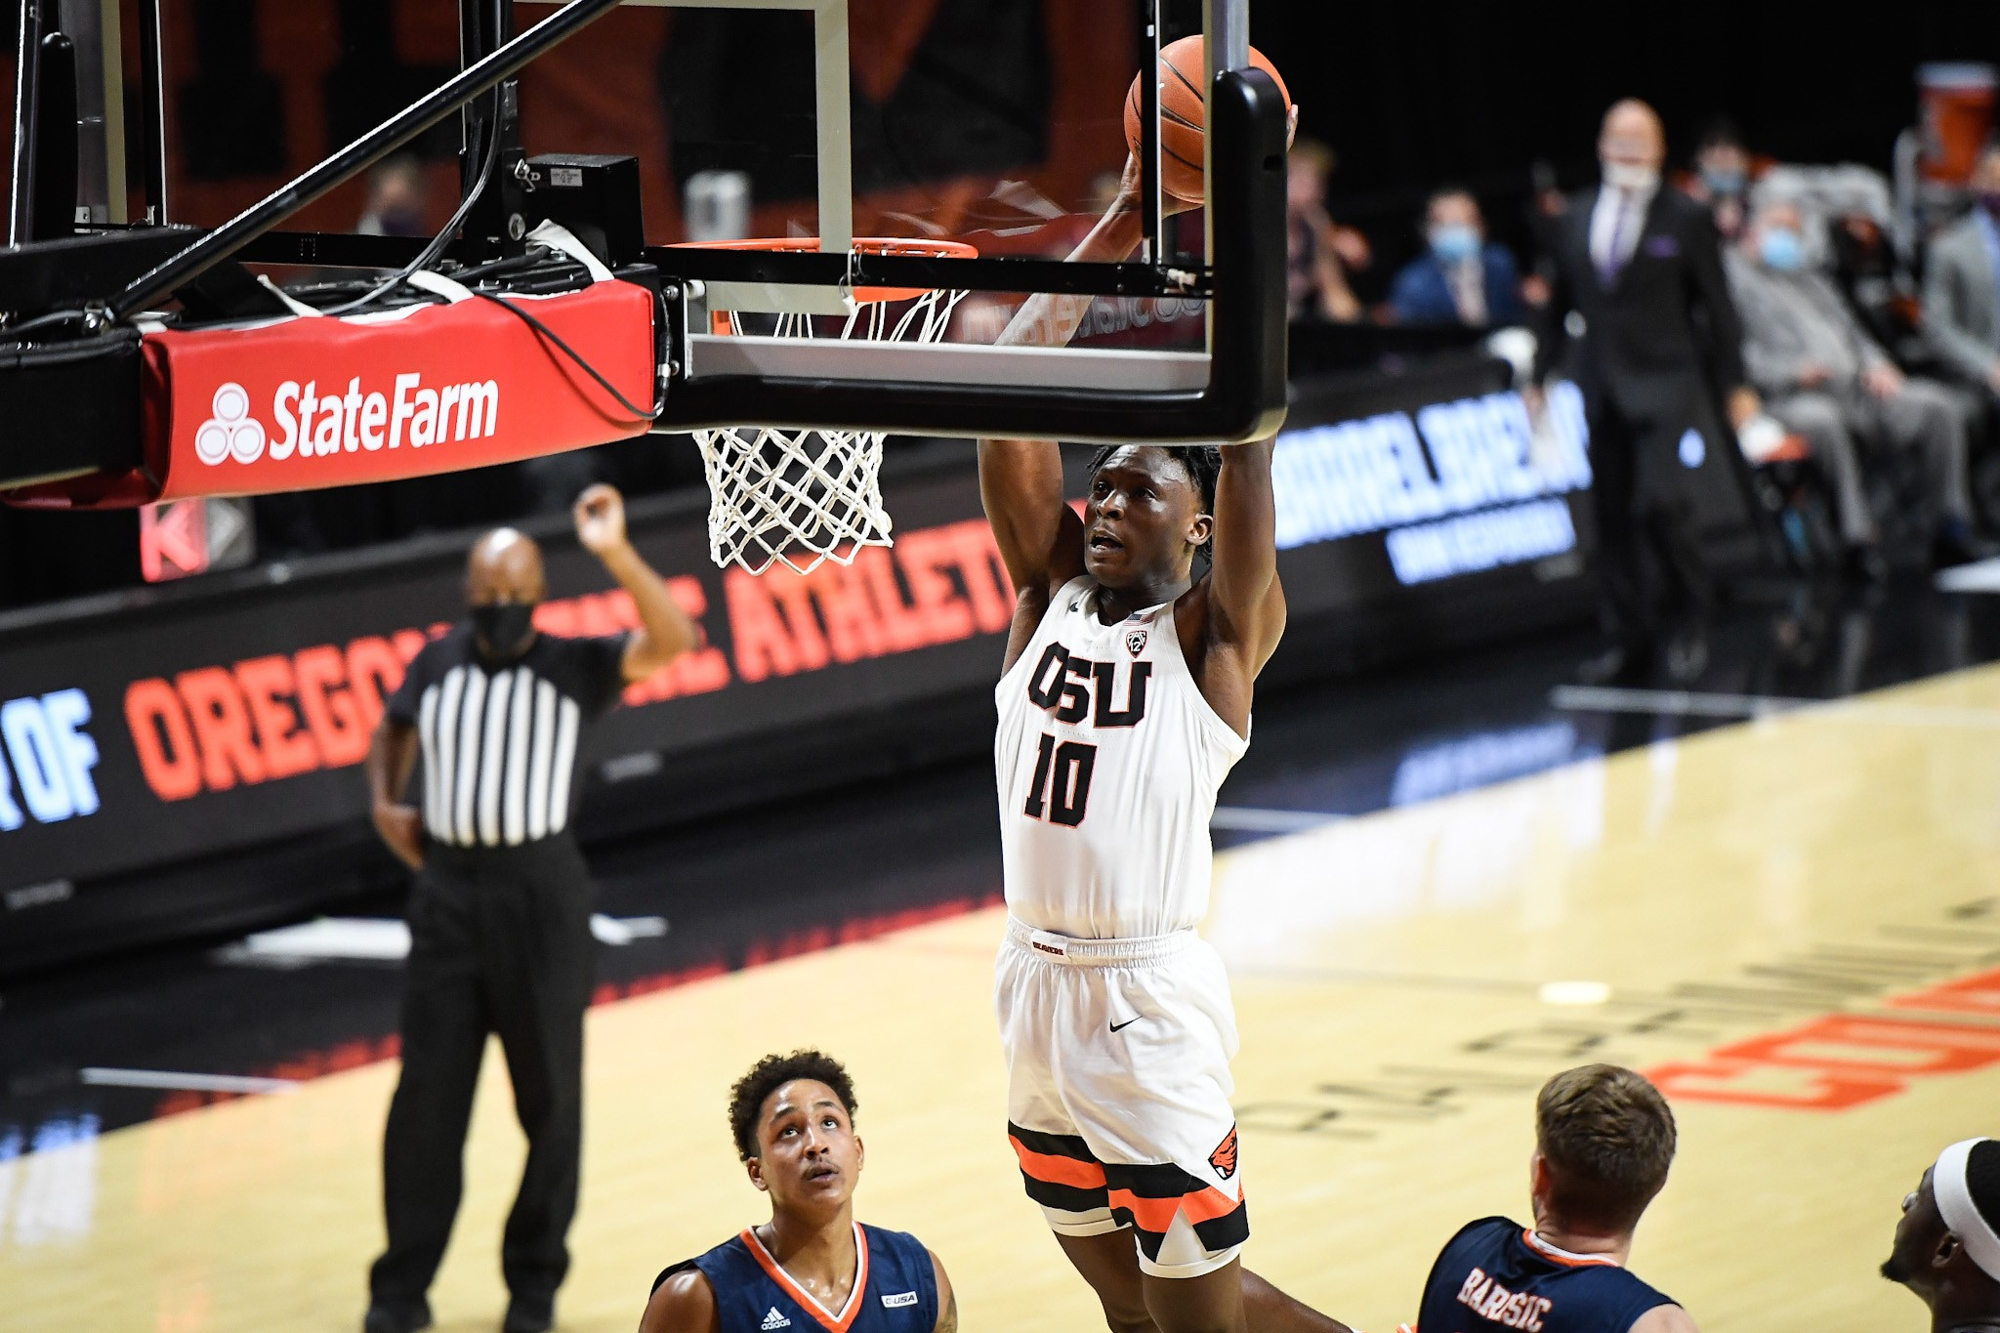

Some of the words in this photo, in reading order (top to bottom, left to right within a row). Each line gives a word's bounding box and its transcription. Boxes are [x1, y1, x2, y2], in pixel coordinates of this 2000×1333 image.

[1028, 641, 1153, 729] OSU
[1130, 642, 1141, 652] 12
[2, 687, 101, 824] OF
[1023, 732, 1098, 829] 10
[760, 1318, 792, 1331] adidas
[1457, 1266, 1553, 1333] BARSIC
